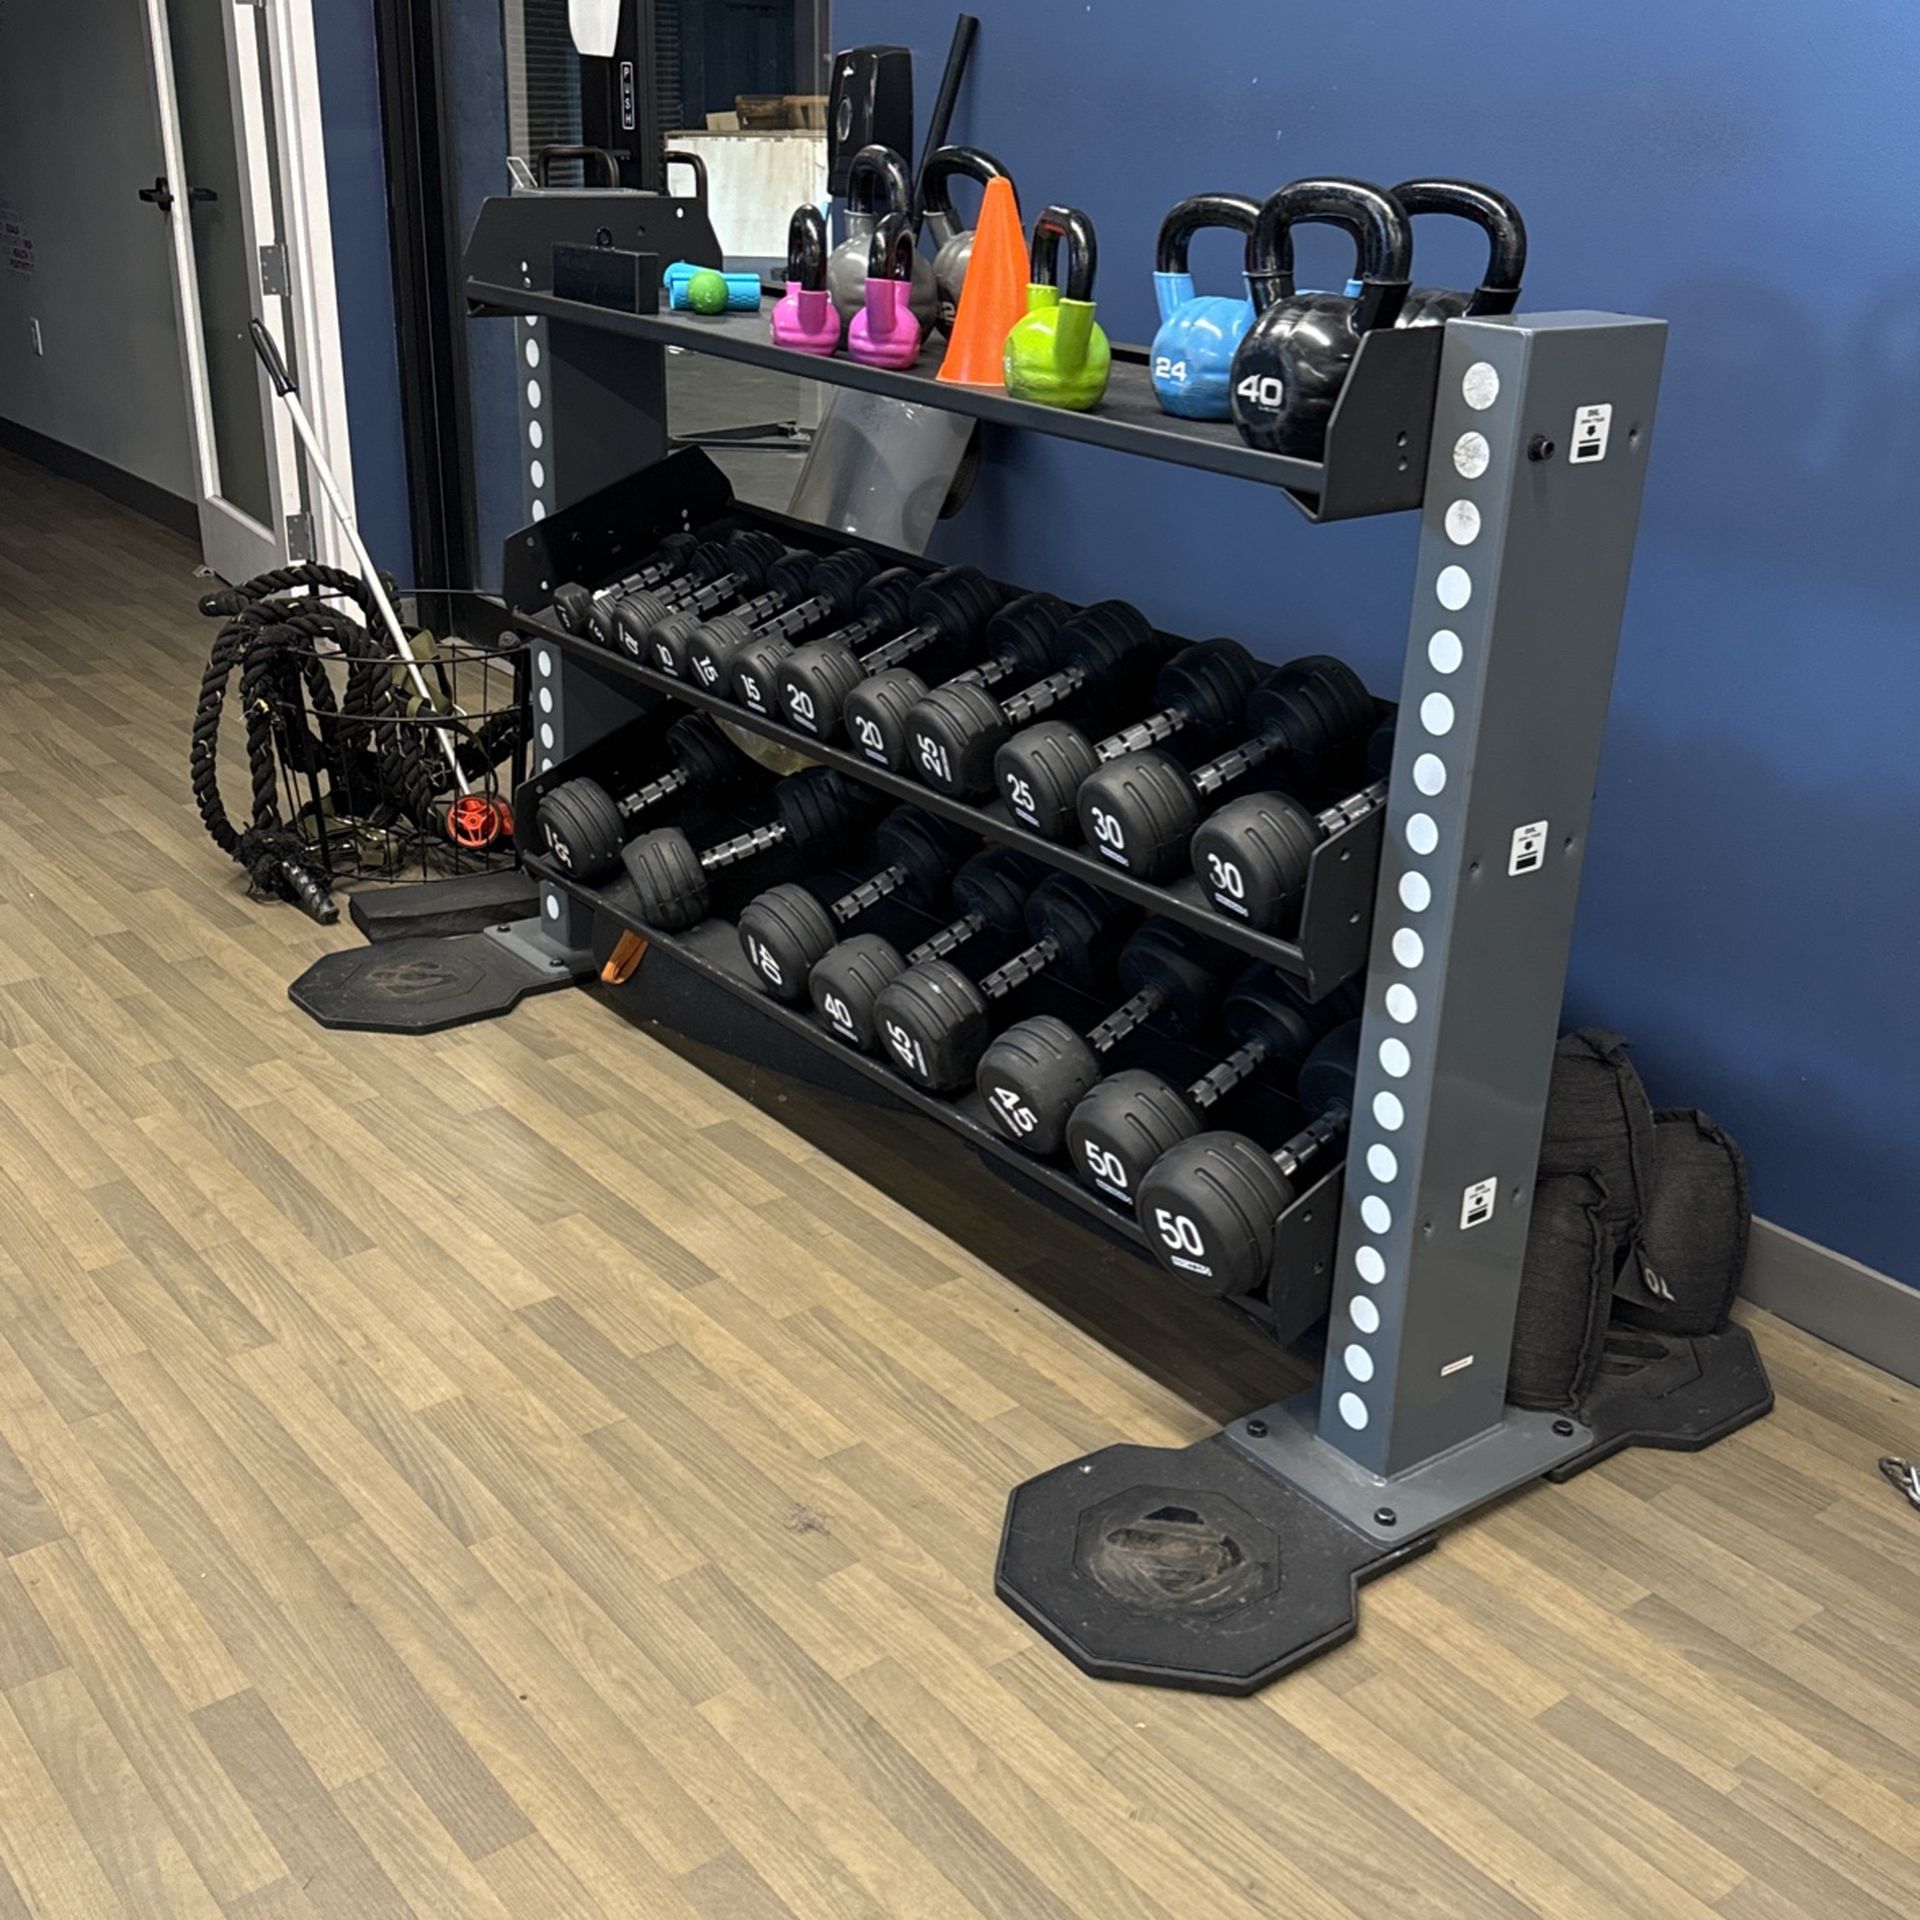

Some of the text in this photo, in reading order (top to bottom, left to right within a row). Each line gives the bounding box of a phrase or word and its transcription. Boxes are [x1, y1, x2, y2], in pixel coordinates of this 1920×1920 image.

[1155, 356, 1187, 382] 24
[1237, 374, 1284, 407] 40
[656, 643, 674, 667] 10
[699, 656, 719, 683] 15
[740, 674, 761, 701] 15
[787, 683, 815, 719] 20
[855, 716, 884, 751] 20
[916, 734, 943, 777] 25
[1007, 773, 1036, 812] 25
[1091, 806, 1124, 850] 30
[552, 832, 573, 868] 35
[1207, 853, 1244, 899] 30
[759, 944, 782, 985] 40
[824, 993, 853, 1028] 40
[886, 1020, 916, 1069] 45
[994, 1087, 1038, 1132] 45
[1084, 1140, 1128, 1188] 50
[1155, 1208, 1205, 1257] 50
